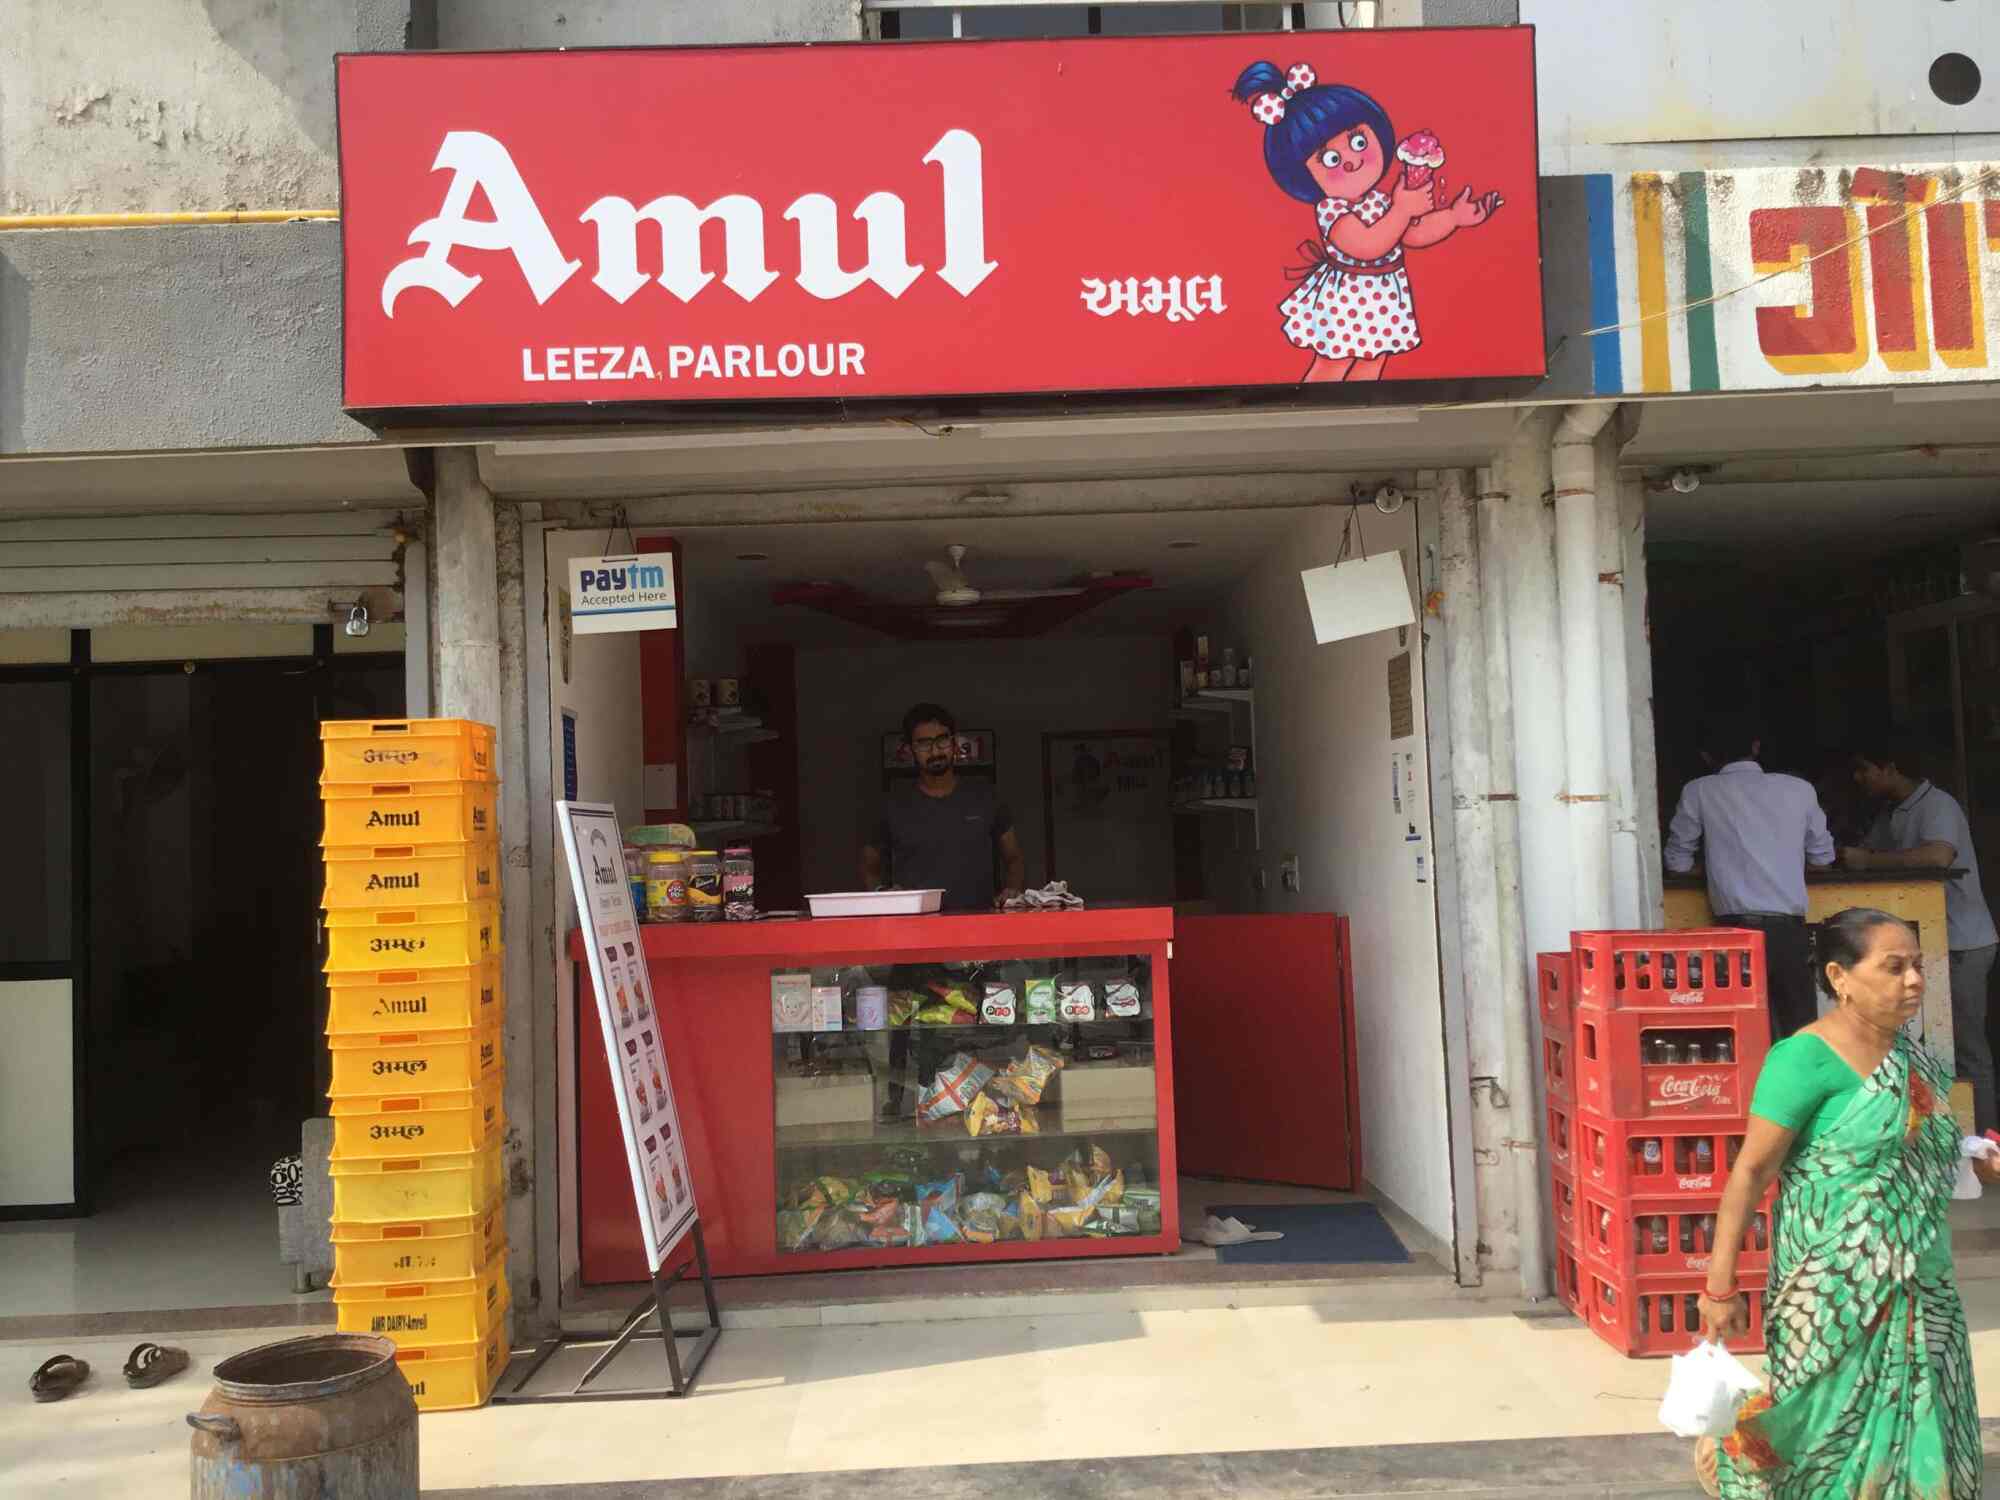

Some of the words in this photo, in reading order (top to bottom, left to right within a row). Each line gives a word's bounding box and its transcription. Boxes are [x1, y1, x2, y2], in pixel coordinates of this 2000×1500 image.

[381, 129, 999, 319] Amul
[1080, 274, 1228, 322] અમૂલ
[522, 346, 655, 381] LEEZA
[669, 343, 865, 378] PARLOUR
[581, 593, 635, 607] Accepted
[638, 592, 667, 602] Here
[366, 810, 420, 829] Amul
[365, 872, 420, 891] Amul
